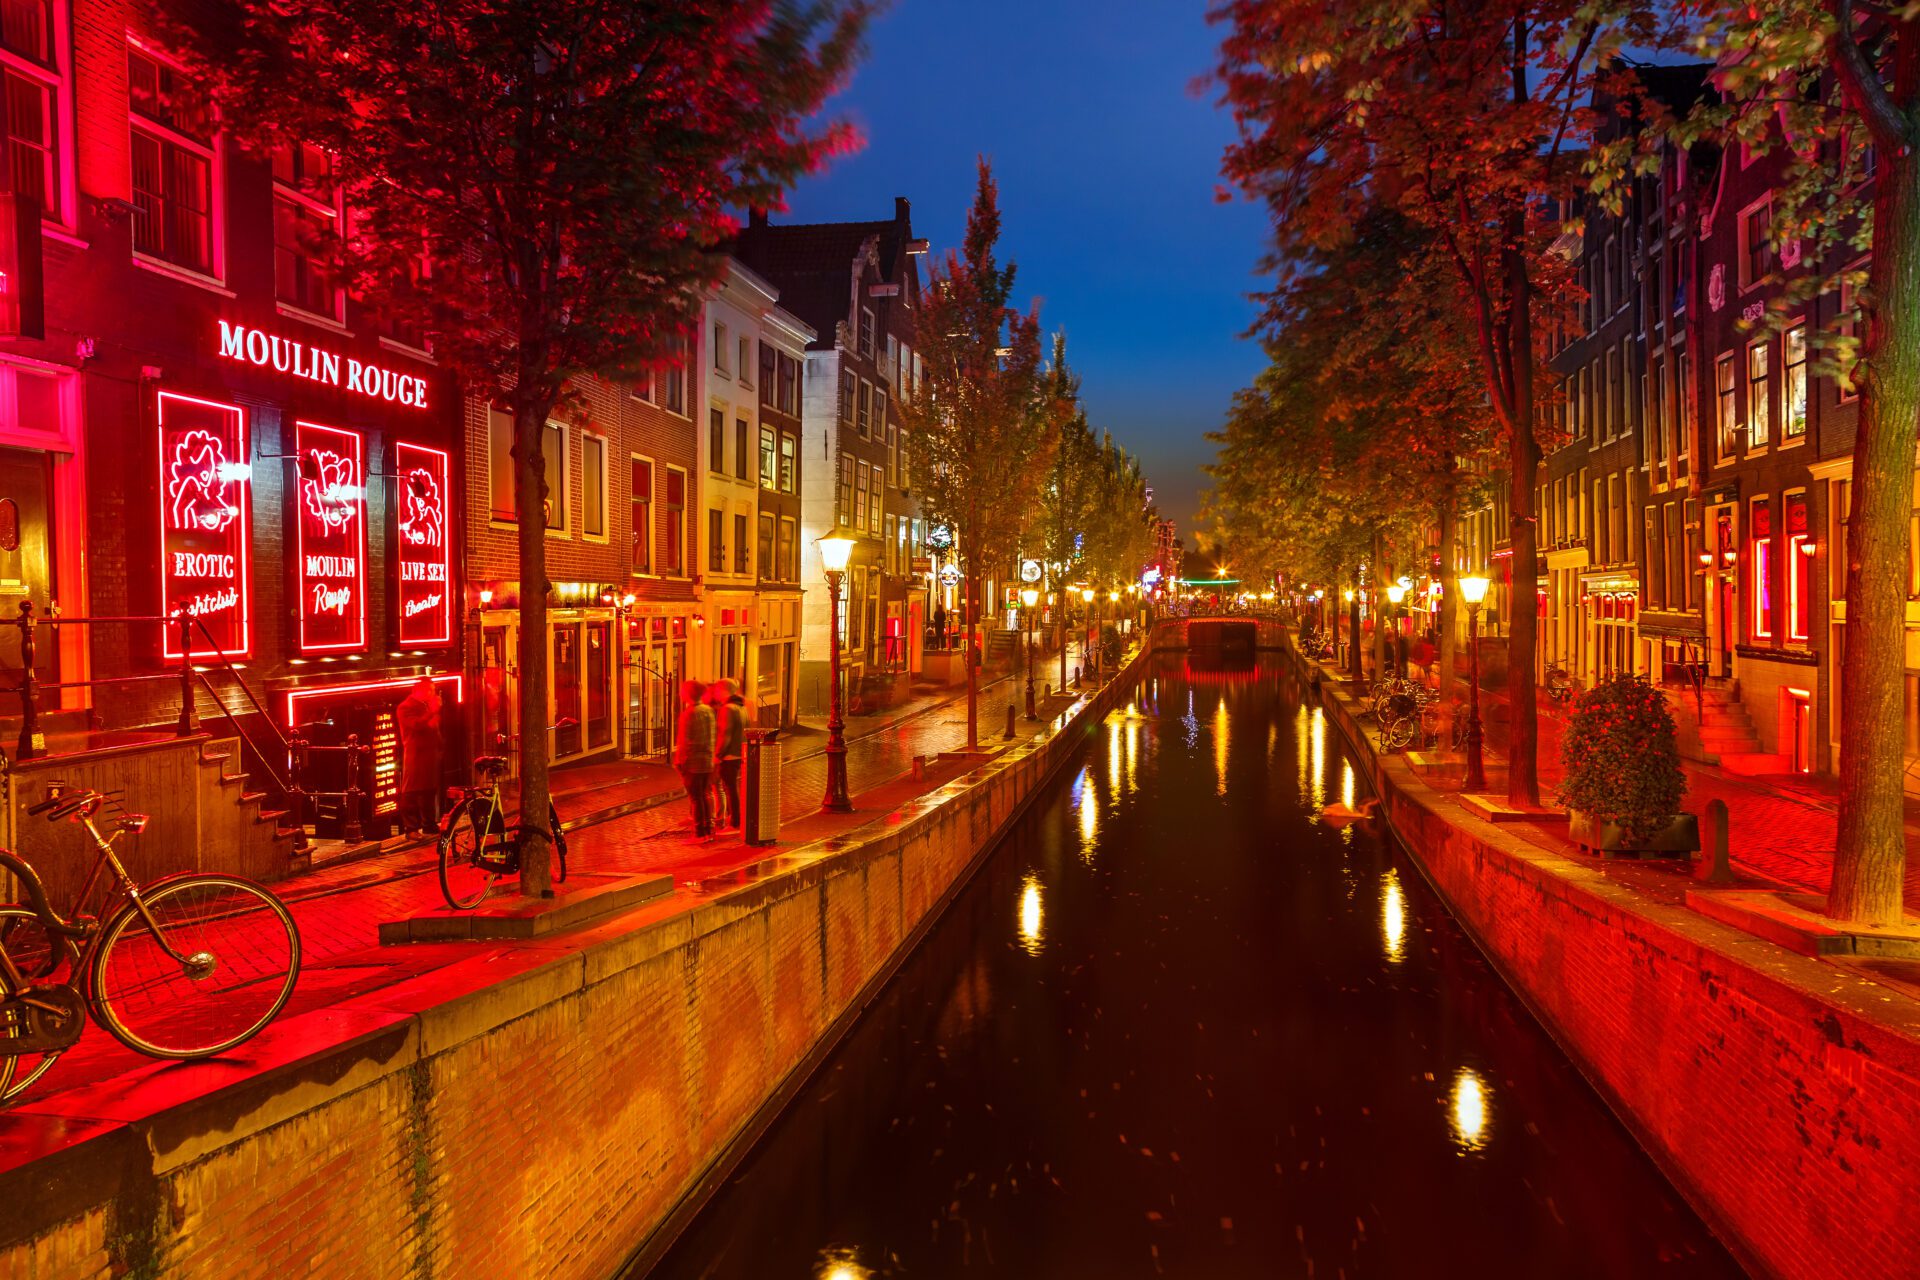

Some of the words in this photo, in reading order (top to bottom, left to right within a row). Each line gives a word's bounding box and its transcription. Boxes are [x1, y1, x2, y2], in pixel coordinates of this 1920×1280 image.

[218, 320, 340, 386] MOULIN
[347, 359, 428, 409] ROUGE
[174, 551, 234, 578] EROTIC
[306, 555, 356, 578] MOULIN
[401, 561, 425, 581] LIVE
[427, 563, 446, 581] SEX
[312, 583, 351, 616] Rouge
[405, 593, 442, 617] theater
